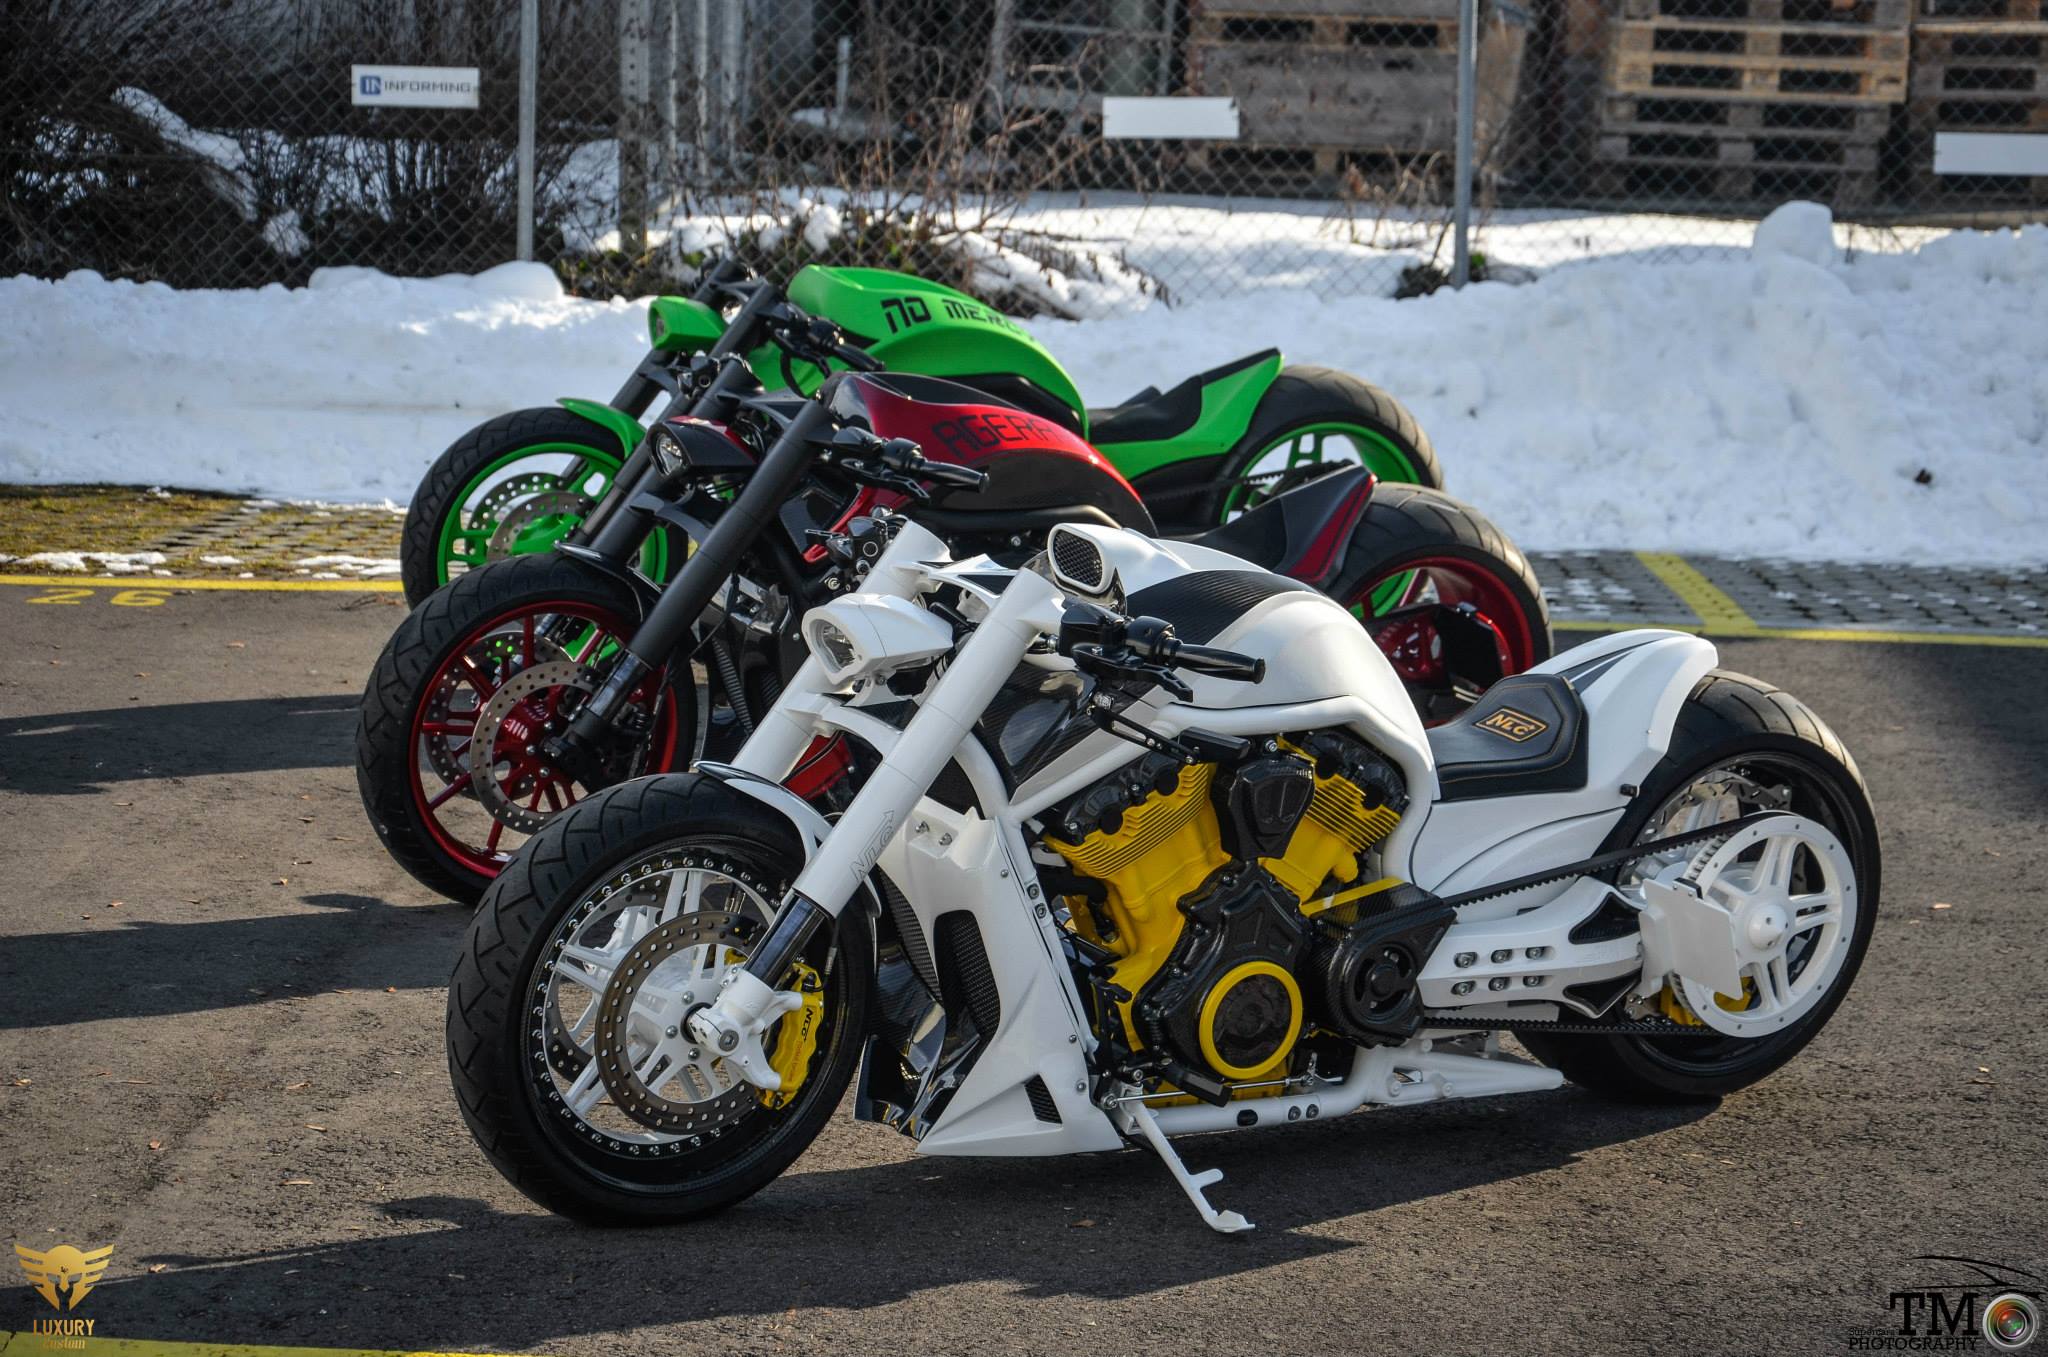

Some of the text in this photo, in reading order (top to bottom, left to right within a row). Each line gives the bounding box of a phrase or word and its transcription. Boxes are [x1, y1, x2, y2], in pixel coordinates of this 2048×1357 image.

[384, 80, 471, 93] INFORMING
[880, 297, 932, 334] NO
[25, 588, 174, 606] 26
